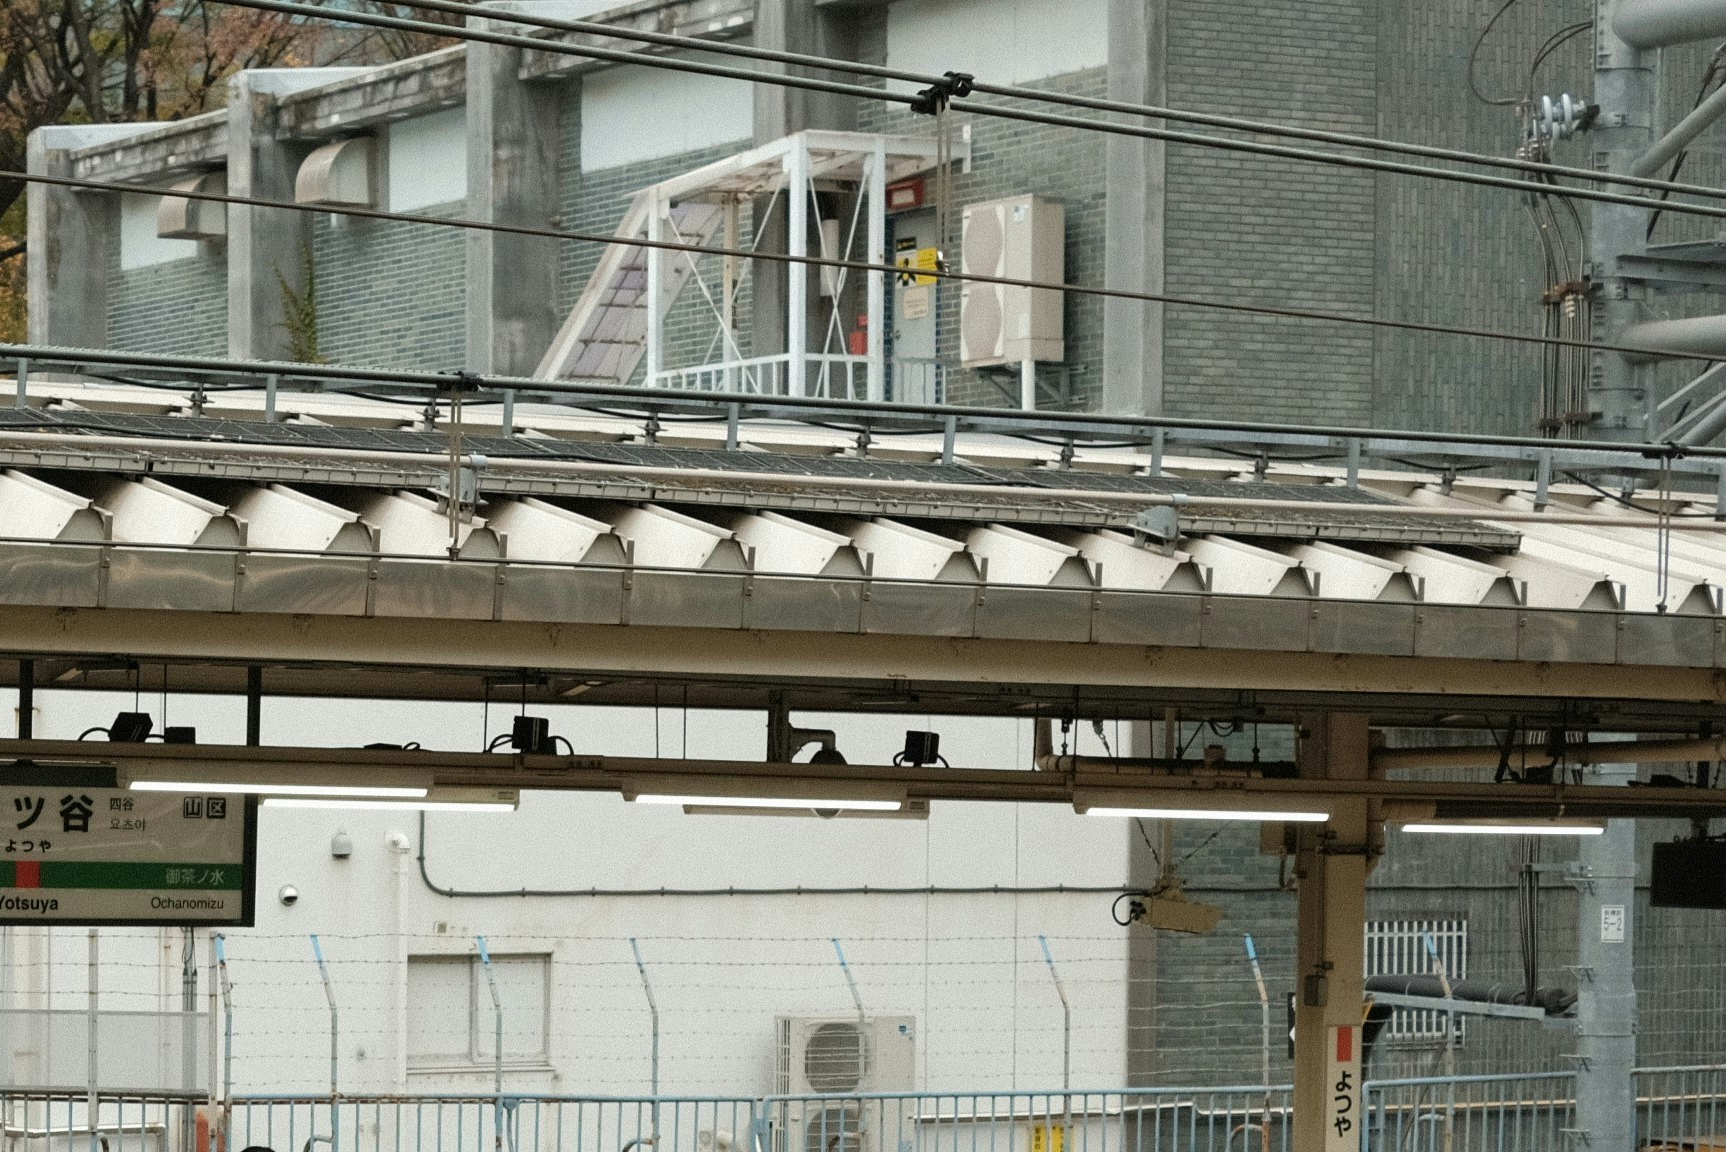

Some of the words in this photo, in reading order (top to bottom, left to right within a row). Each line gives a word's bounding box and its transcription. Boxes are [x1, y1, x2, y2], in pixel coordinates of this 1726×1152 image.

[110, 797, 134, 811] 四谷
[184, 797, 202, 818] 山
[207, 797, 226, 819] 区
[5, 839, 52, 853] よつや
[166, 868, 225, 885] 御茶ノ水
[150, 897, 225, 910] Ochanomizu
[1334, 1071, 1352, 1138] よつや
